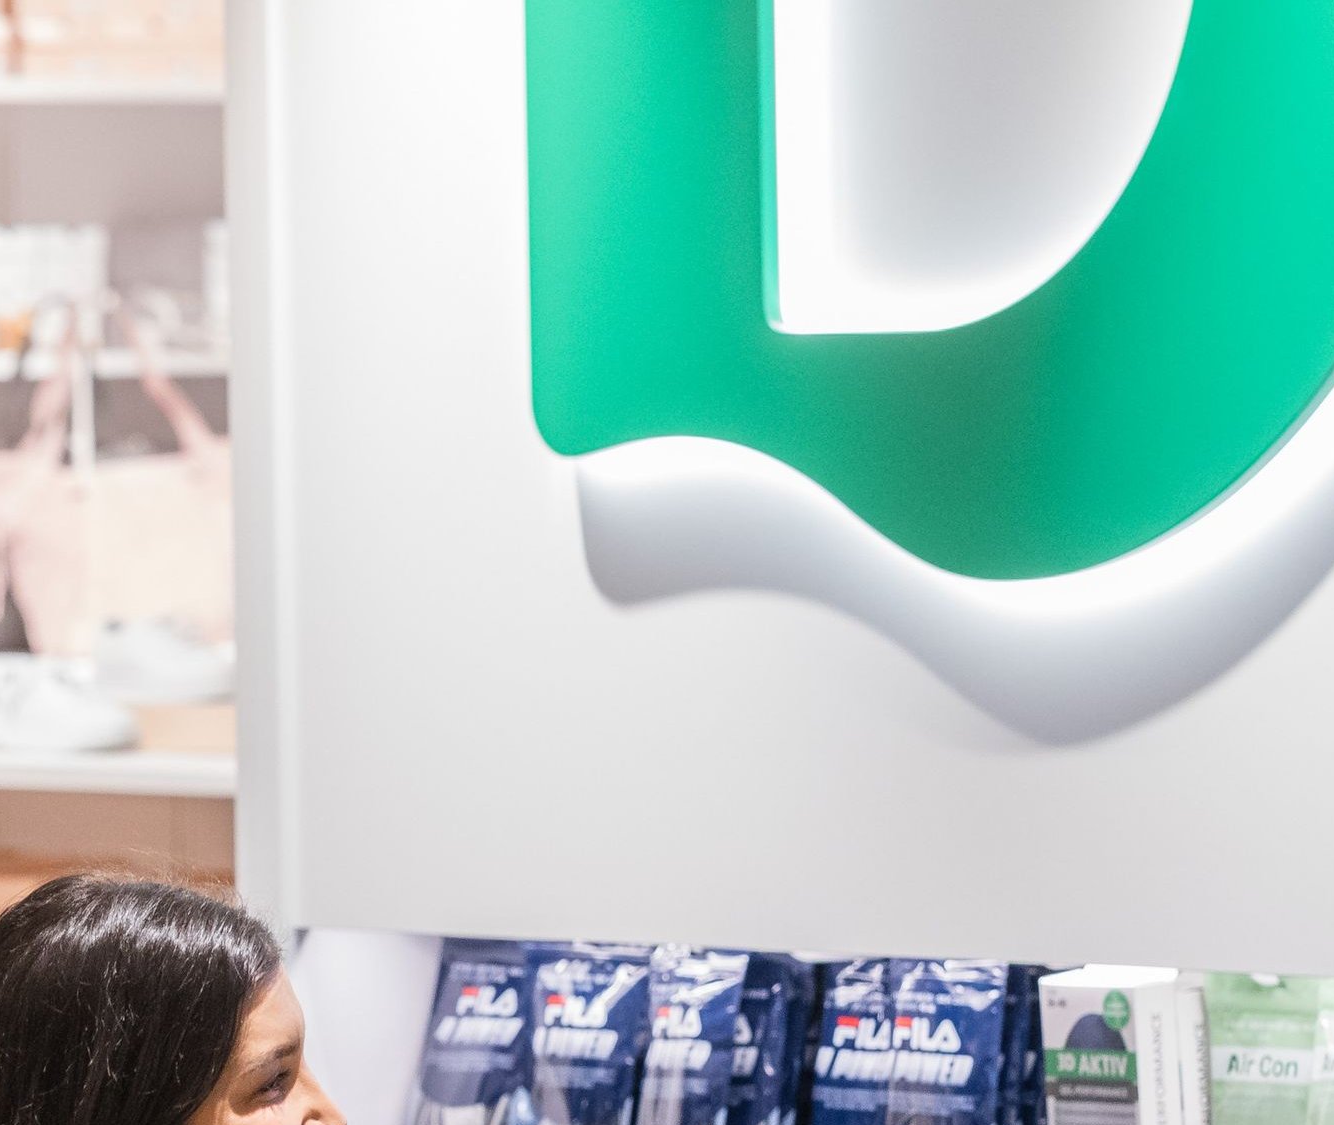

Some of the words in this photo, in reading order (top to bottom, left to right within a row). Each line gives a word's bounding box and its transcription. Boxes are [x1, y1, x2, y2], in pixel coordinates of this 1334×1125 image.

[892, 1015, 962, 1053] FILA
[1079, 1053, 1128, 1079] AKTIV
[1258, 1054, 1299, 1079] Con
